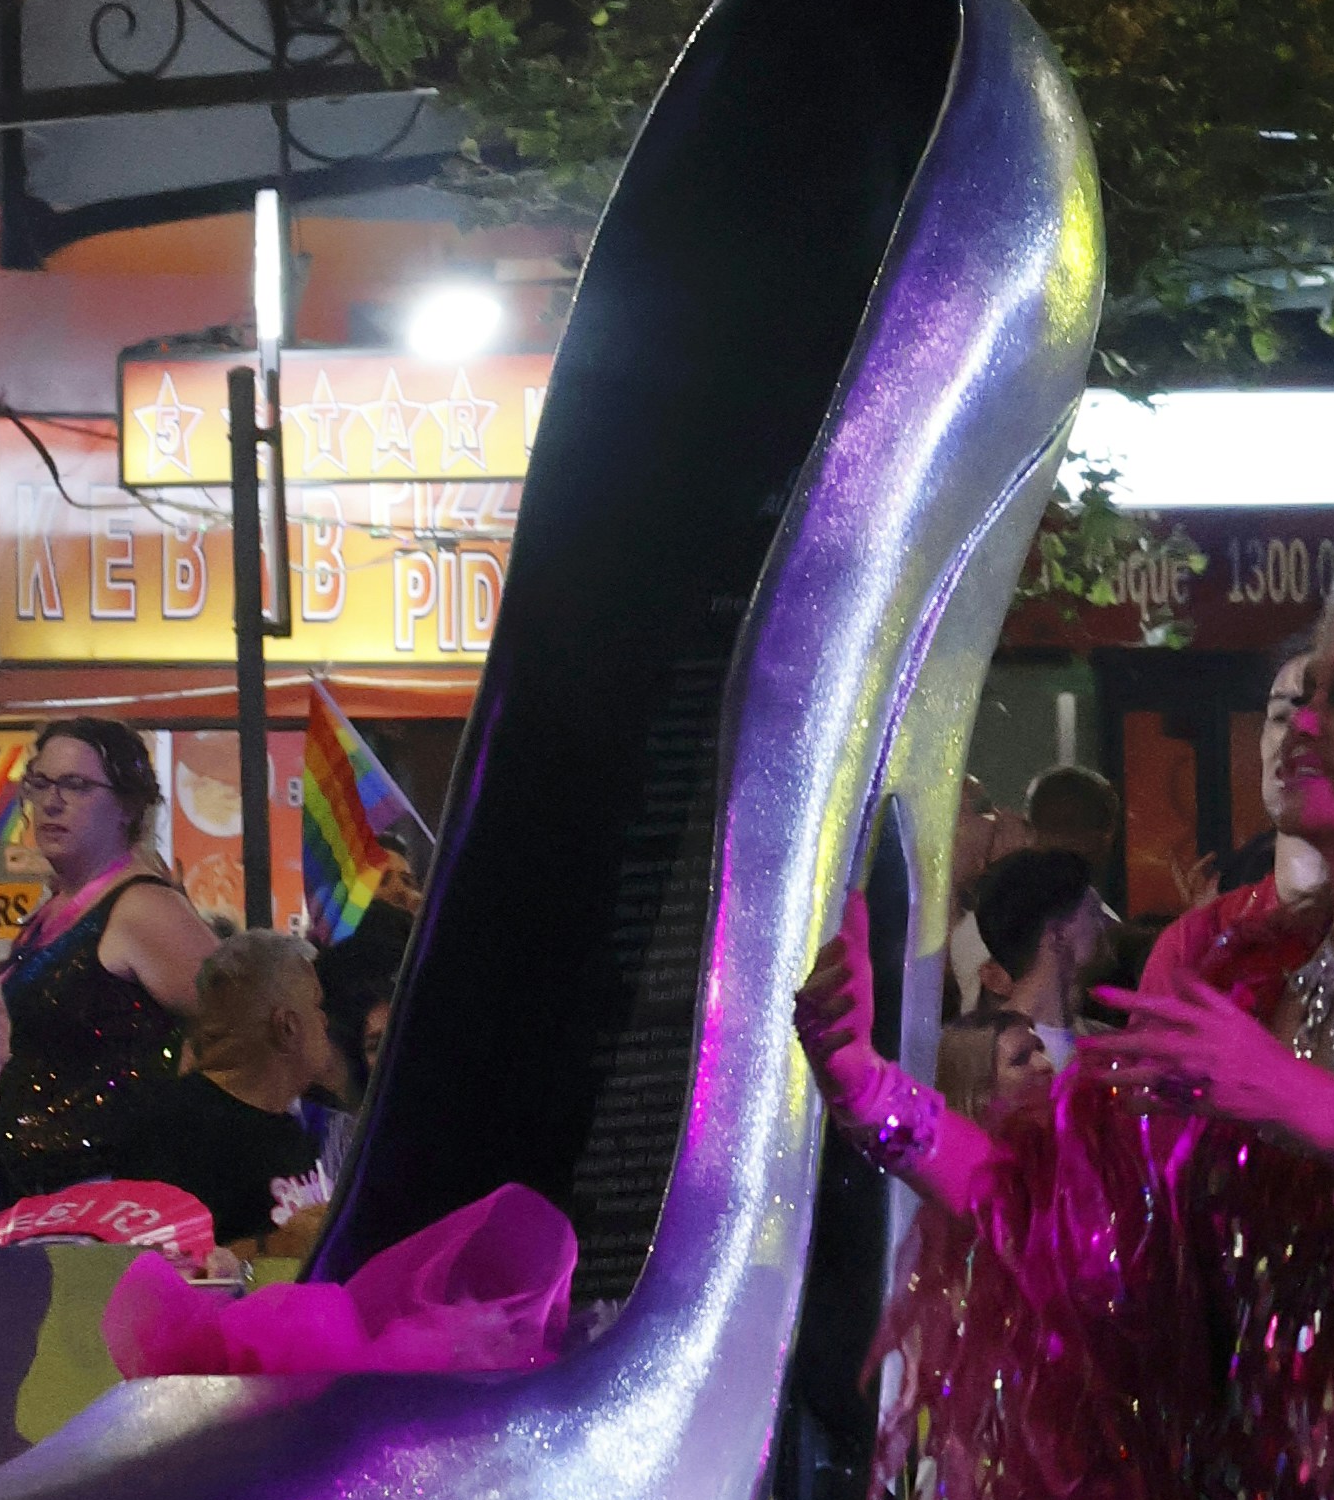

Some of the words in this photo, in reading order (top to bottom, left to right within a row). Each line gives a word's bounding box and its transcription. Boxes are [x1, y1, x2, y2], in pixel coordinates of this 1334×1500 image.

[155, 403, 181, 455] 5
[255, 401, 479, 453] TAR
[370, 483, 520, 539] PIZZ
[15, 484, 347, 623] KEBB
[1226, 536, 1309, 605] 1300
[394, 549, 507, 652] PID
